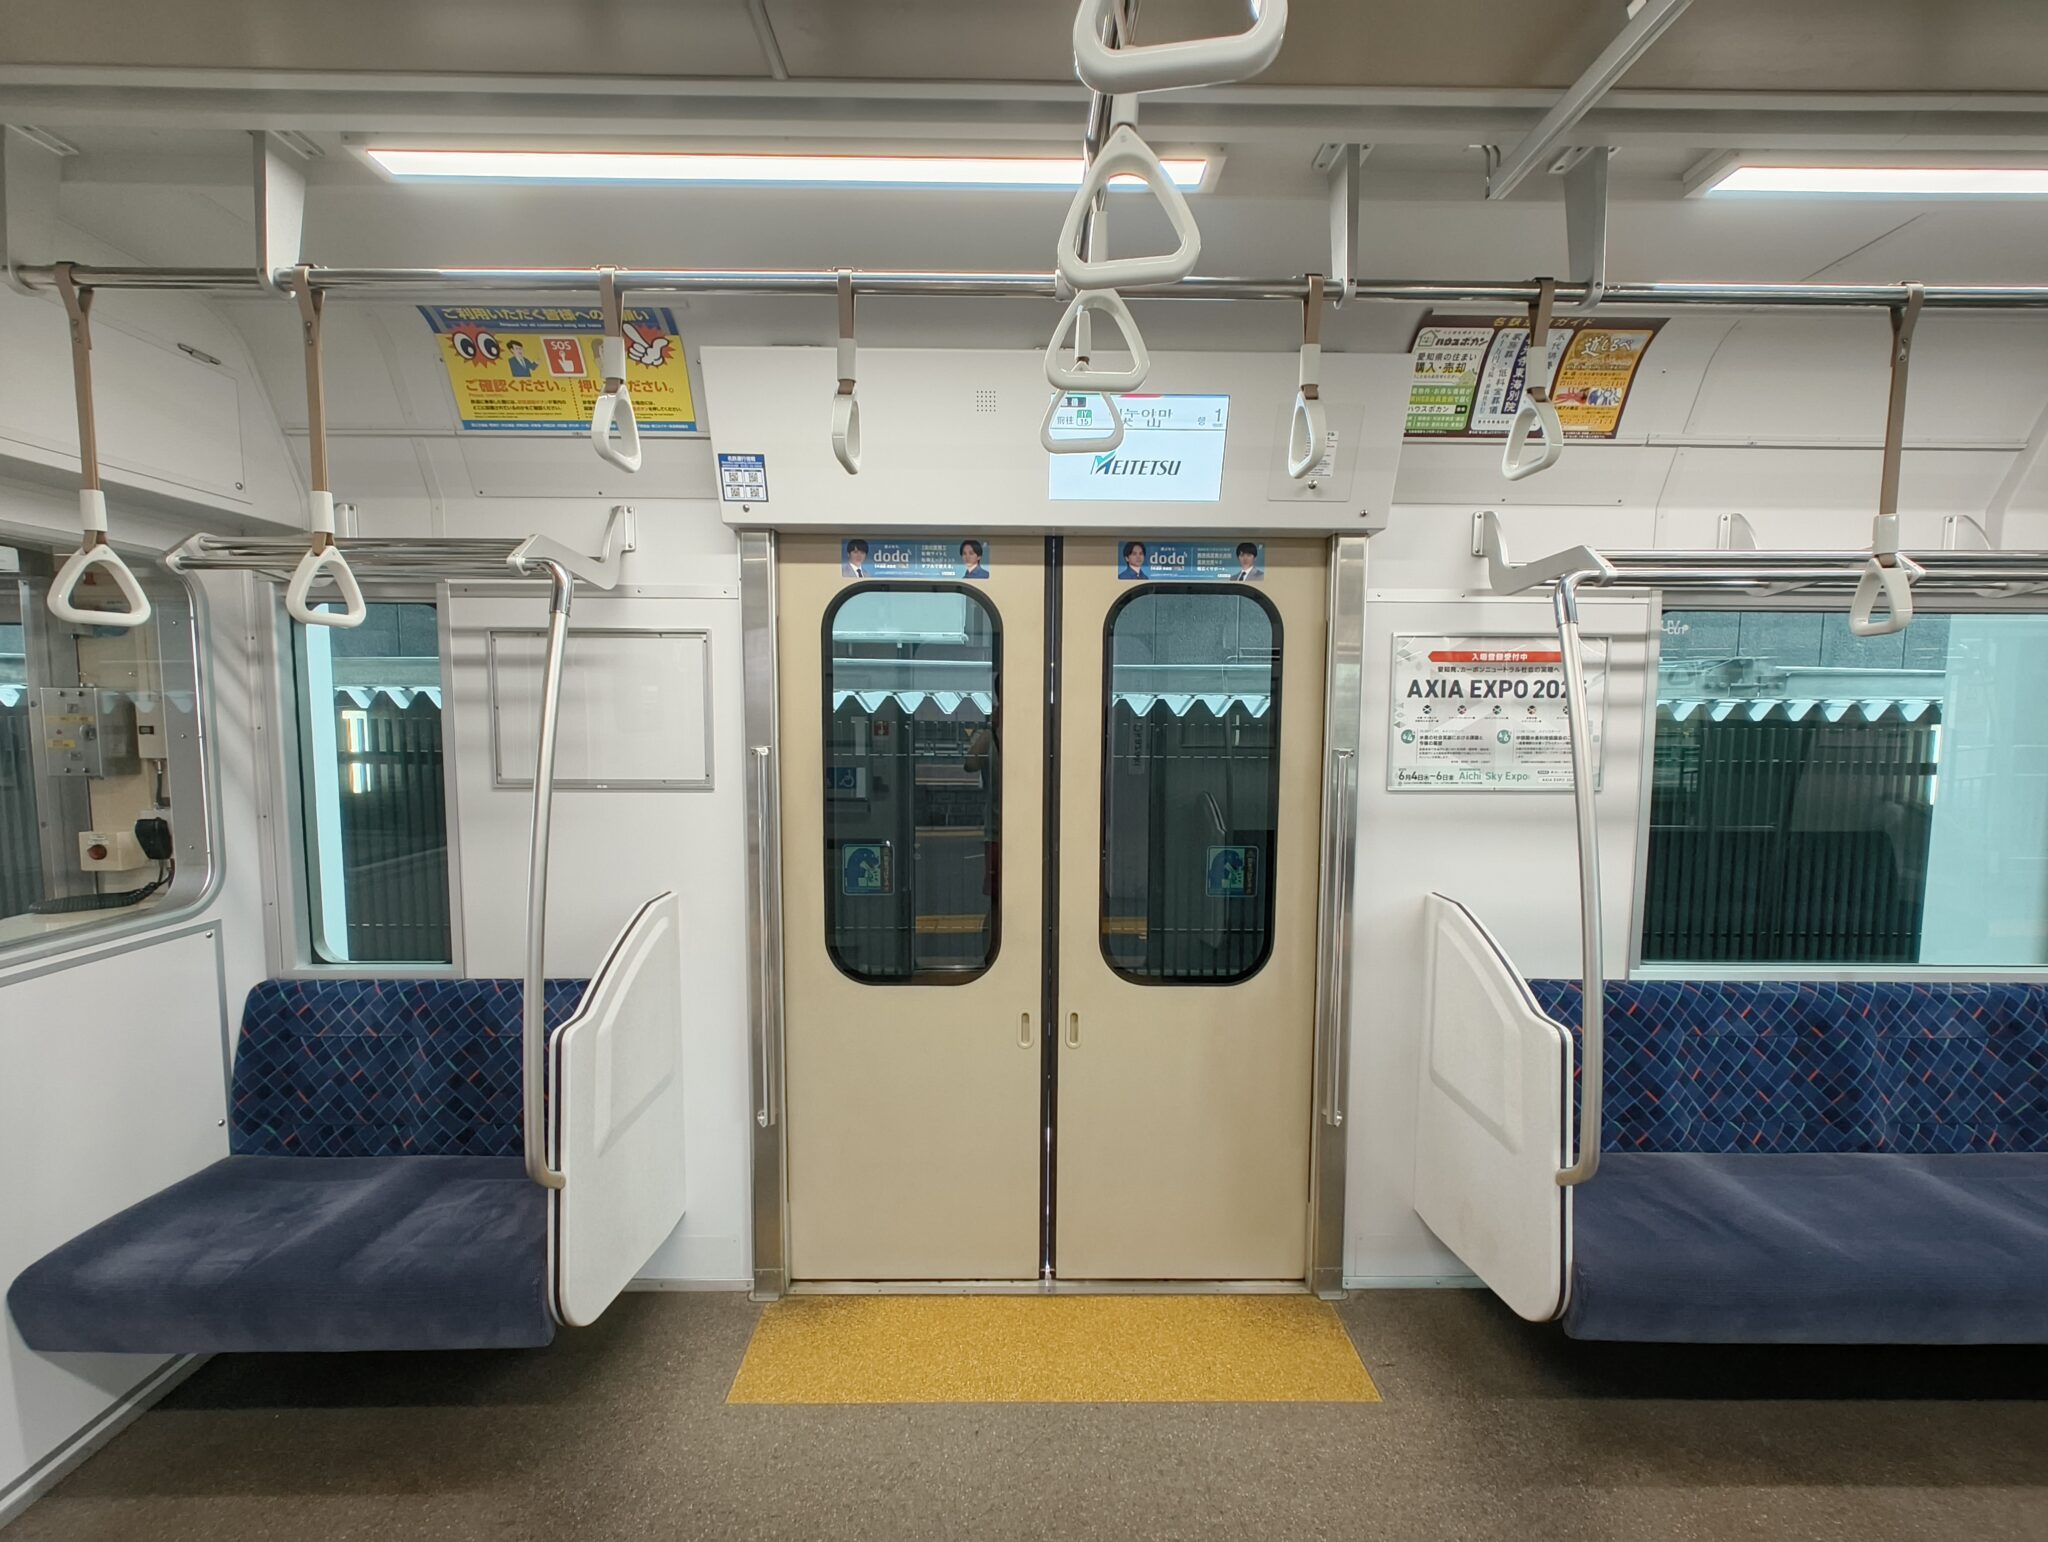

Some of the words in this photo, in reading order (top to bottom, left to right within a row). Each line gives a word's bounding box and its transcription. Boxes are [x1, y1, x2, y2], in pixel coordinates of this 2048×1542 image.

[551, 341, 571, 350] SOS
[1417, 352, 1477, 361] 愛知県の住まい
[1415, 362, 1467, 373] 購入・売却
[465, 379, 567, 393] ご確認ください。
[579, 379, 674, 393] 押しださい。
[1215, 408, 1222, 422] 1
[1407, 405, 1449, 413] ハウスボカン
[1090, 451, 1181, 475] MEITETSU
[873, 550, 909, 563] doda
[1149, 552, 1185, 565] doda
[1471, 653, 1528, 662] 入場登録受付中
[1407, 679, 1464, 699] AXIA
[1470, 679, 1529, 699] EXPO
[1532, 679, 1587, 699] 202
[1459, 772, 1482, 780] Aichi
[1485, 772, 1502, 782] Sky
[1505, 772, 1528, 782] Expo
